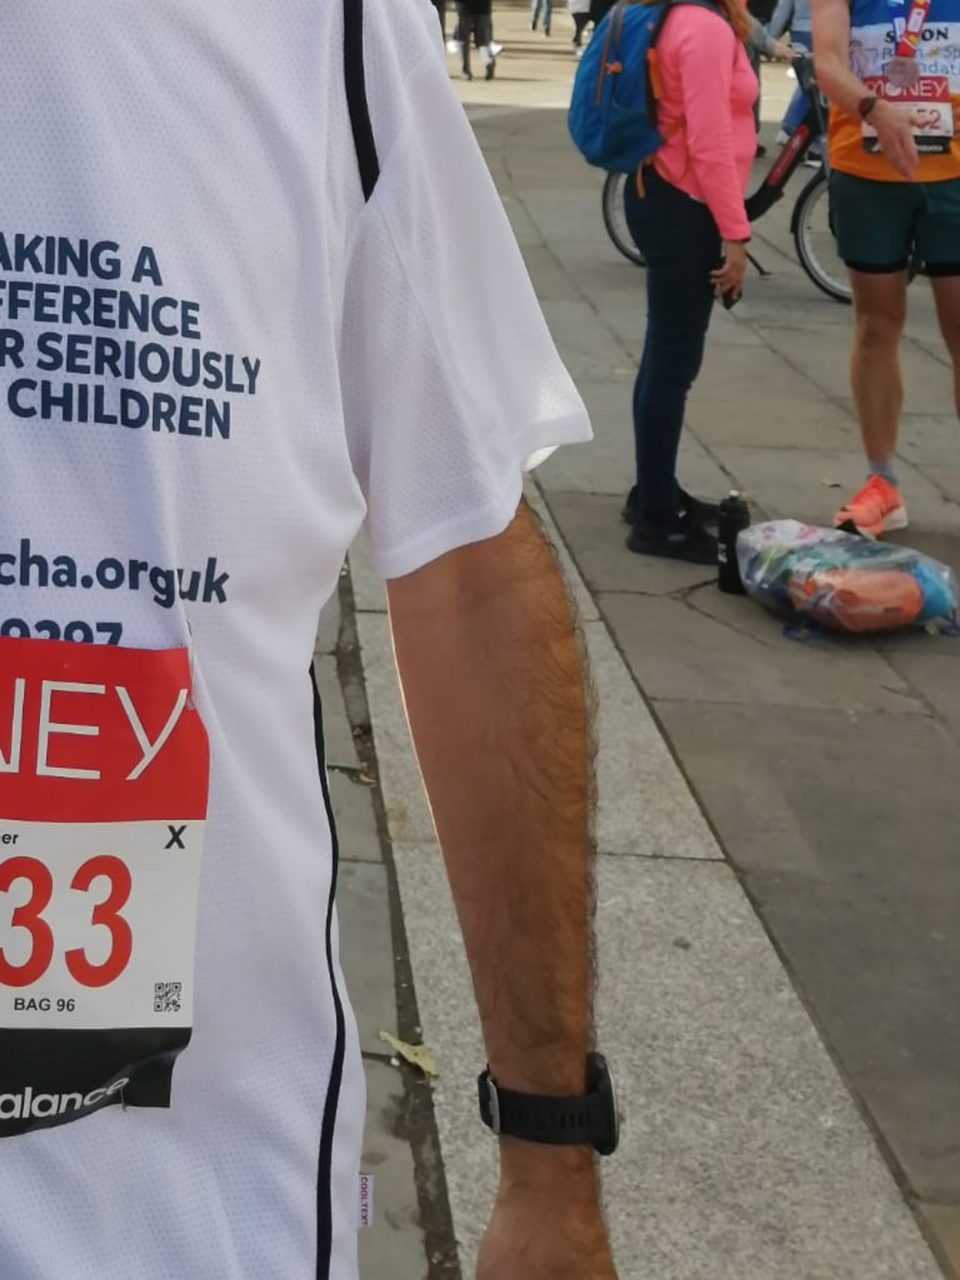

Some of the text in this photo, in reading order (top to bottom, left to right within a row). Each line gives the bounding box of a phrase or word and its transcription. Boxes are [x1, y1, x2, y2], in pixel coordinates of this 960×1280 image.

[131, 245, 163, 287] A
[36, 331, 261, 395] SERIOUSLY
[6, 378, 232, 440] CHILDREN
[164, 825, 187, 850] X
[13, 997, 76, 1013] BAG 96
